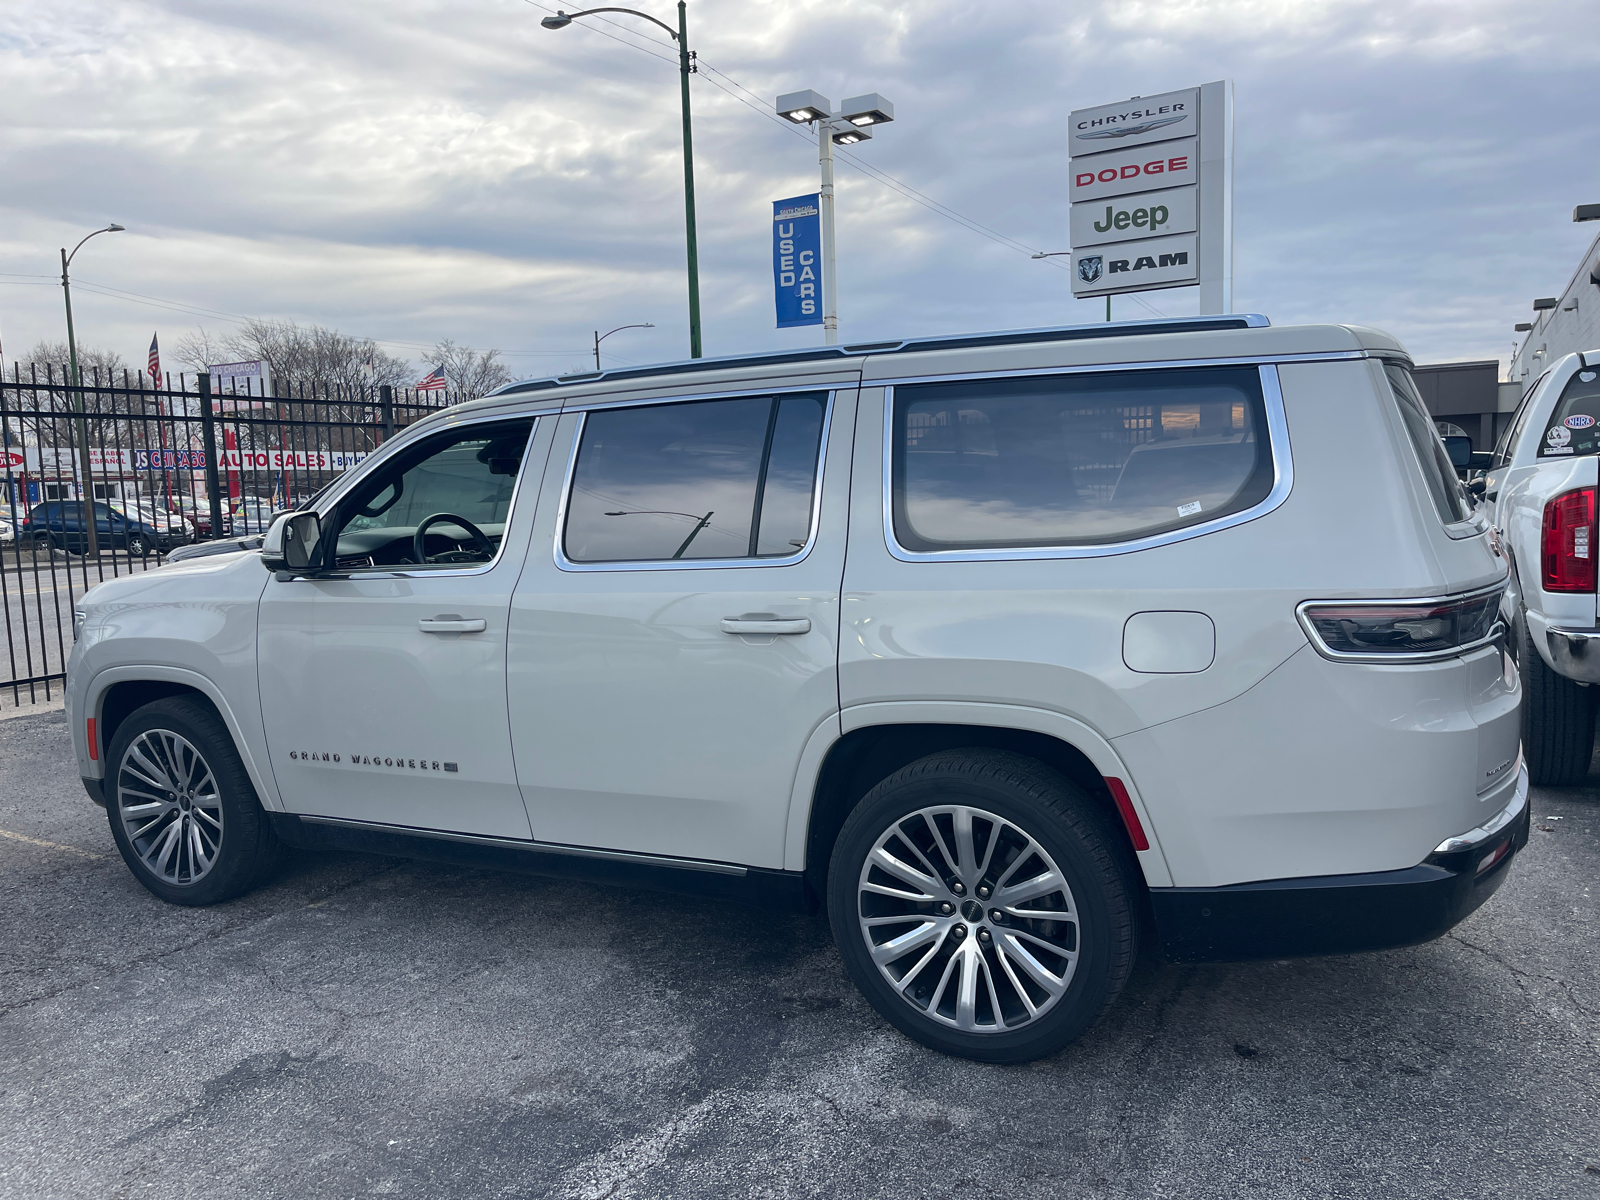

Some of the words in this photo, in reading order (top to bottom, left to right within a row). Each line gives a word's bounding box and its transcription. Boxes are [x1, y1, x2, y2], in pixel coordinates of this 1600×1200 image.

[1077, 103, 1185, 130] CHRYSLER
[1076, 156, 1188, 187] DODGE
[1093, 204, 1169, 233] Jeep
[779, 222, 796, 288] USED
[1109, 251, 1188, 274] RAM
[799, 250, 816, 315] CARS
[213, 365, 223, 375] US
[224, 362, 256, 374] CHICAGO
[1568, 417, 1591, 427] NHRA
[151, 451, 207, 468] CHICAGO
[219, 454, 268, 467] AUTO
[274, 453, 326, 467] SALES
[289, 750, 341, 763] GRAND
[351, 754, 441, 771] WAGONEER
